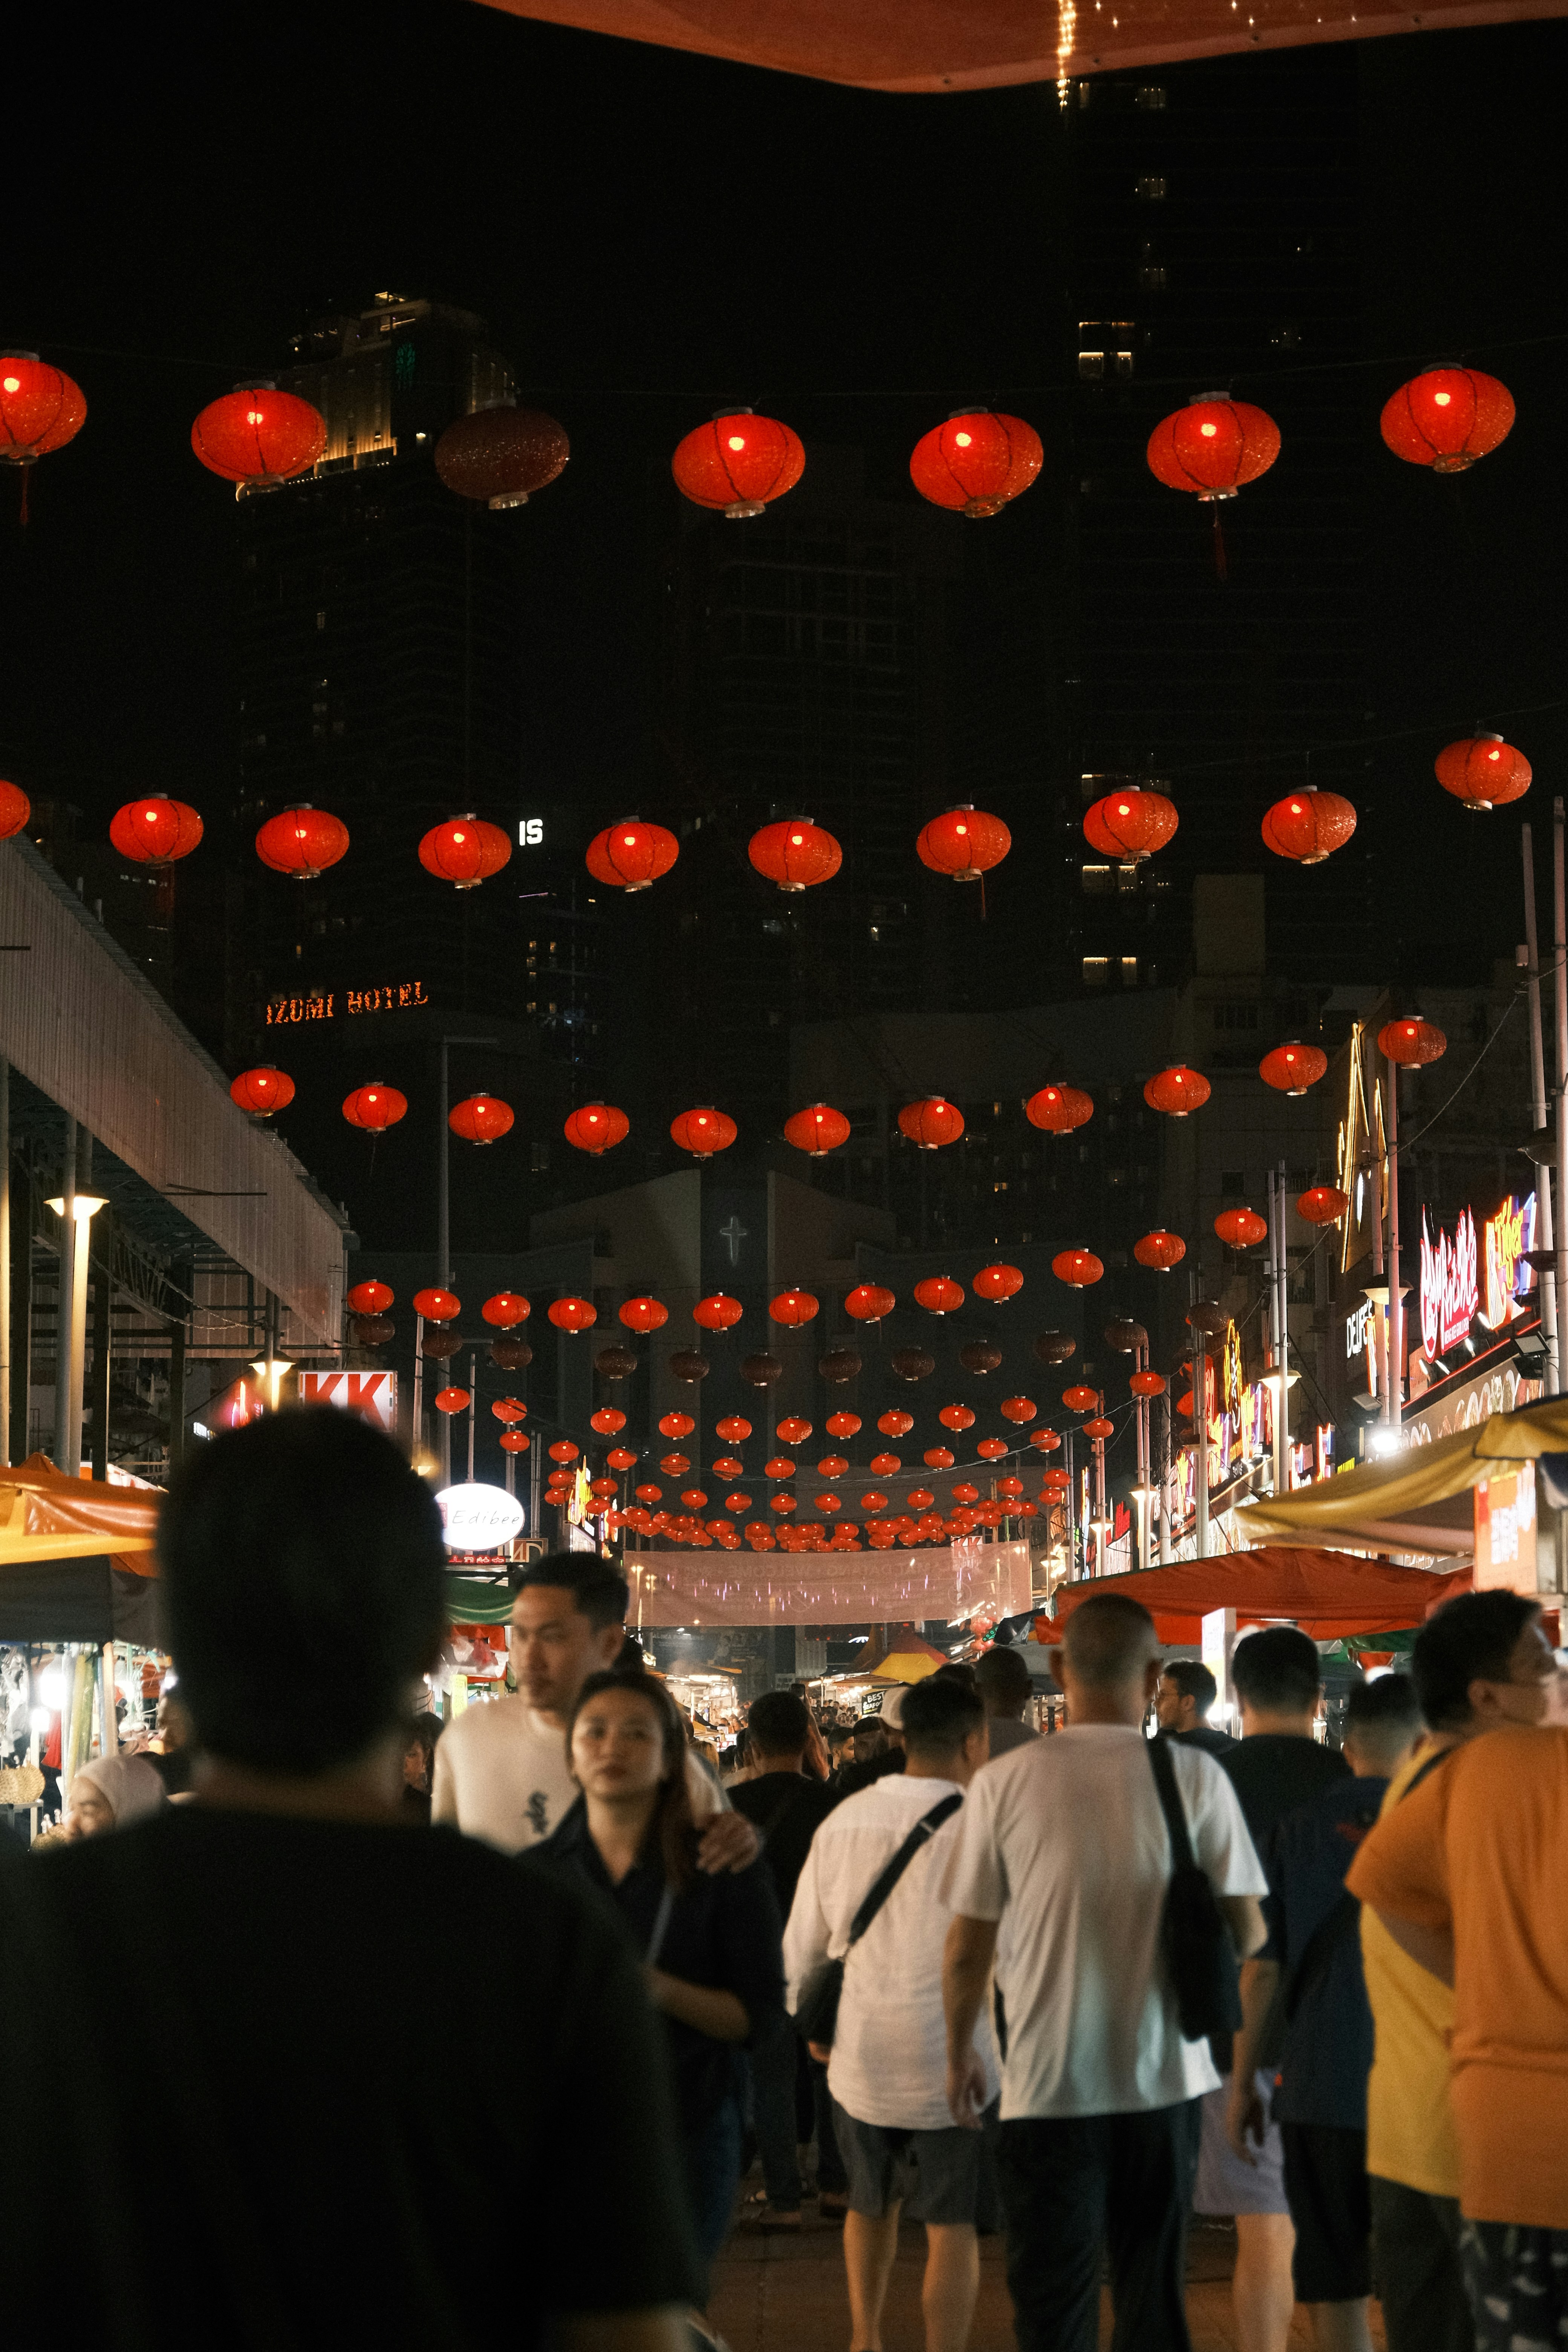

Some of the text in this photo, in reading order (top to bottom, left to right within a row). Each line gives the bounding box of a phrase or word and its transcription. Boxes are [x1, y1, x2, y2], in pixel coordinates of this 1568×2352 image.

[266, 981, 429, 1025] IZUMI HOTEL
[1494, 1196, 1524, 1290] Tiger
[452, 1510, 520, 1524] Edibee
[867, 1691, 885, 1703] BEST
